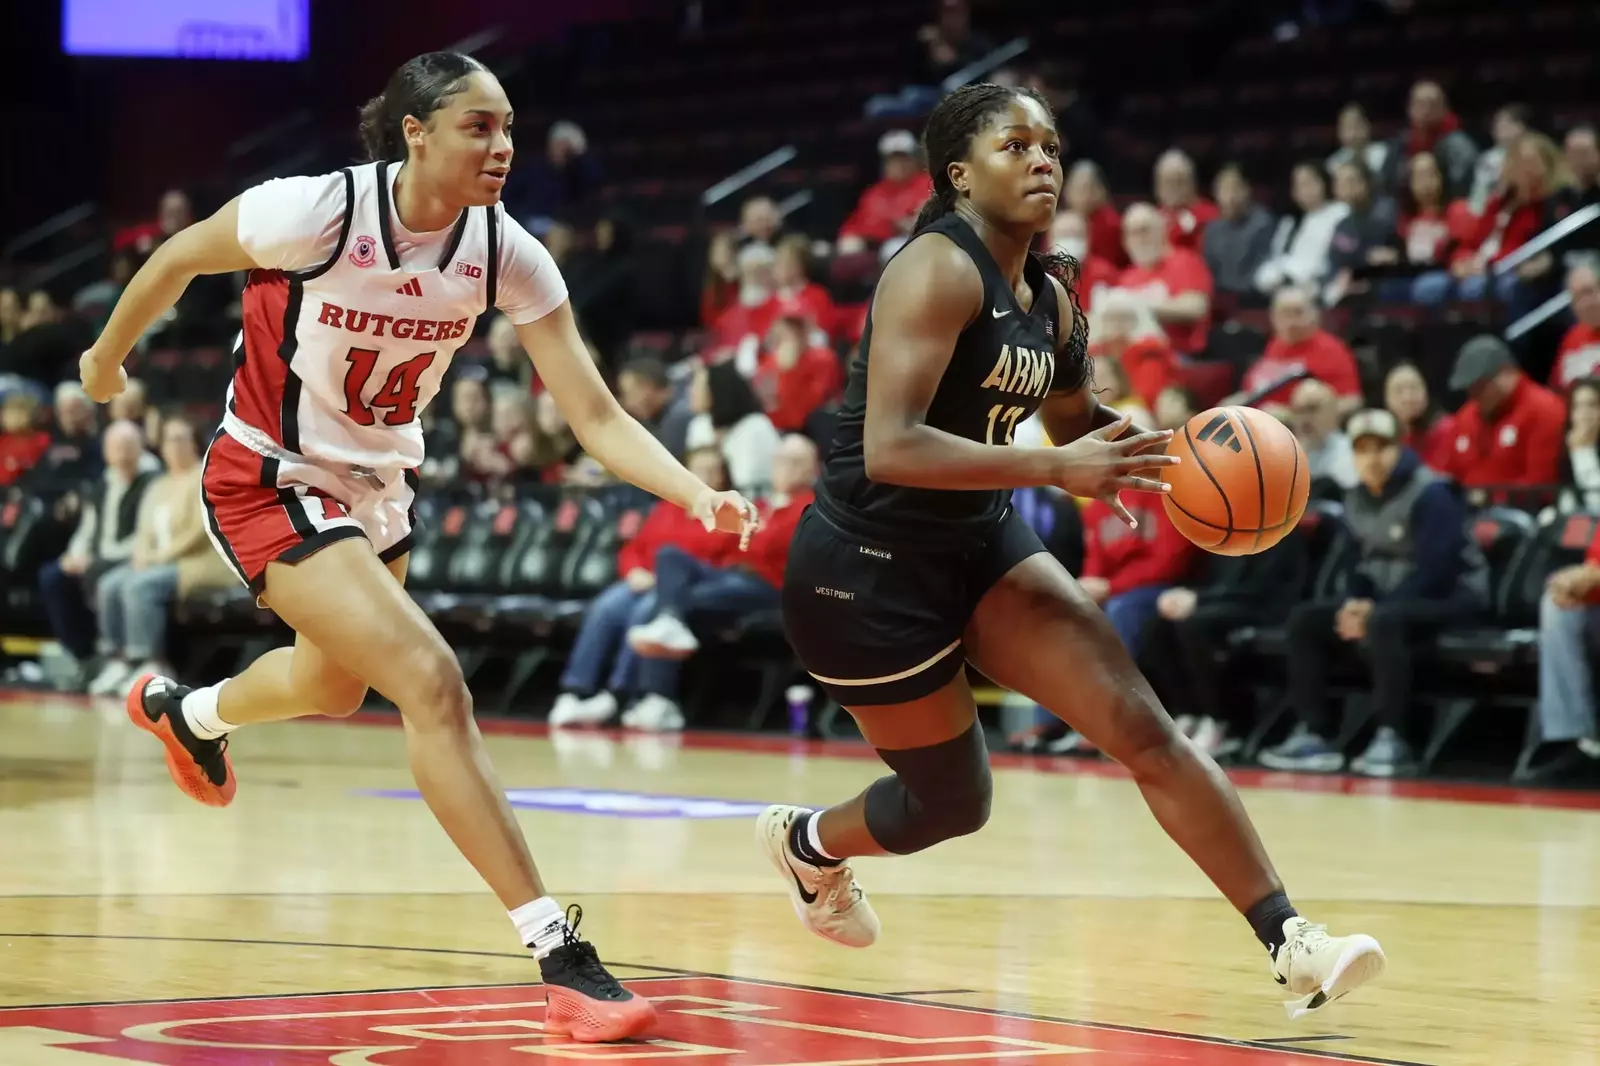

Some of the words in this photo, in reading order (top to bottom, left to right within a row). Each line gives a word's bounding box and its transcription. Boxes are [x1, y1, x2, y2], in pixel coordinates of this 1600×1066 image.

[318, 302, 469, 341] RUTGERS
[340, 346, 437, 426] 14
[860, 546, 892, 560] LEAGUE
